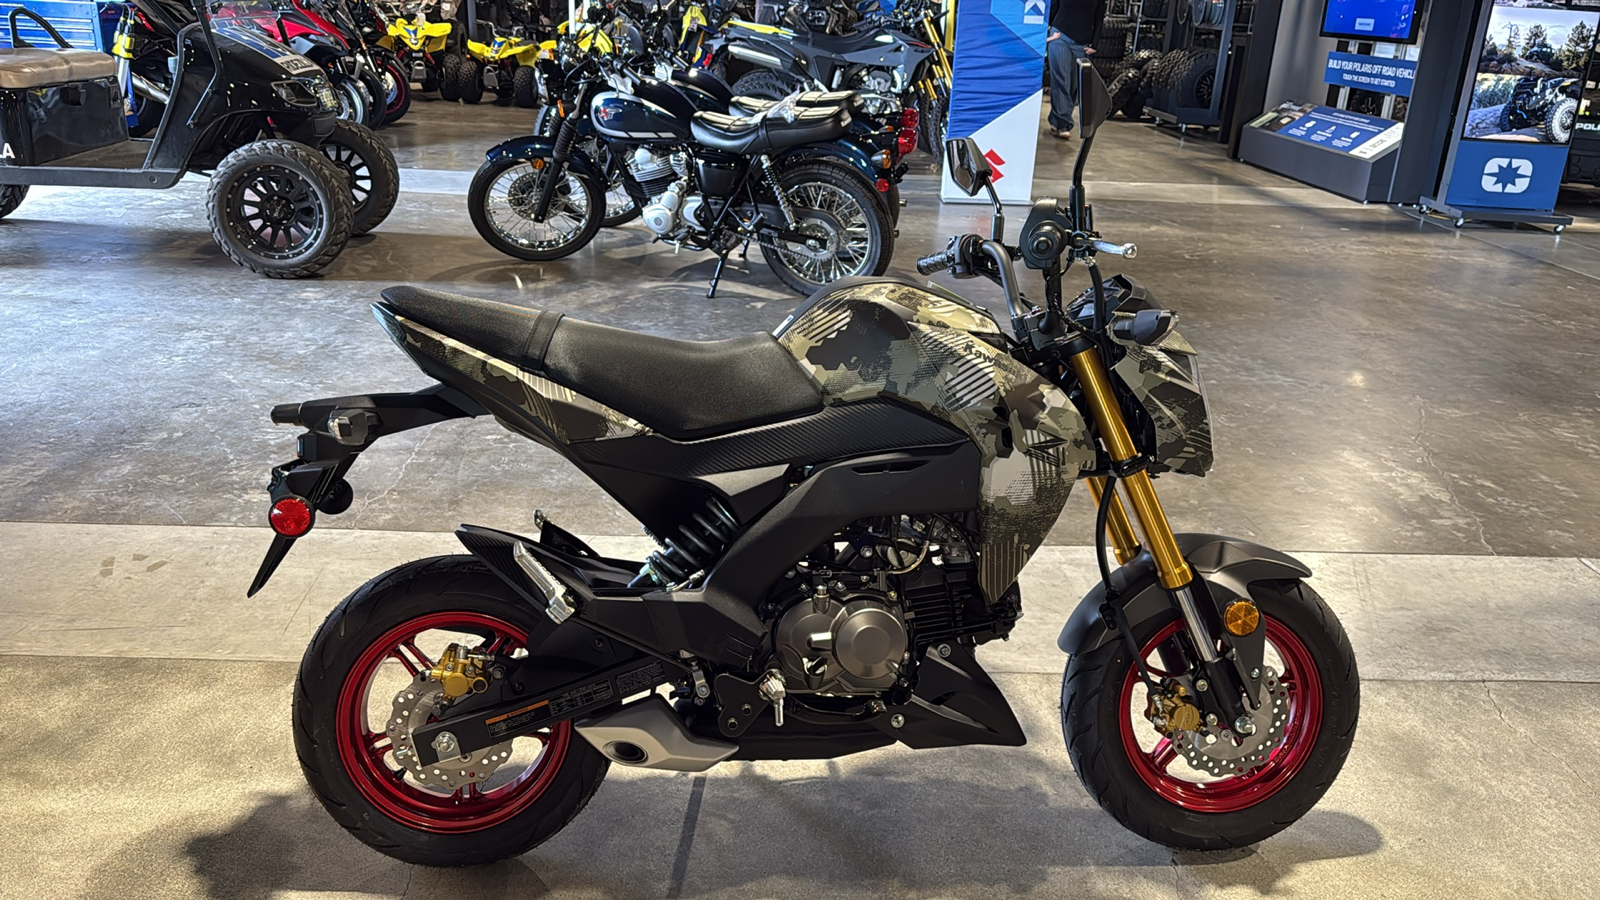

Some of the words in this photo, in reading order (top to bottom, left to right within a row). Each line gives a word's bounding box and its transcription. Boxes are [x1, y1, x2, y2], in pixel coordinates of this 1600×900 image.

[1328, 59, 1341, 69] BUILD
[1341, 60, 1353, 71] YOUR
[1353, 62, 1372, 73] POLARIS
[1372, 64, 1382, 75] OFF
[1382, 65, 1395, 76] ROAD
